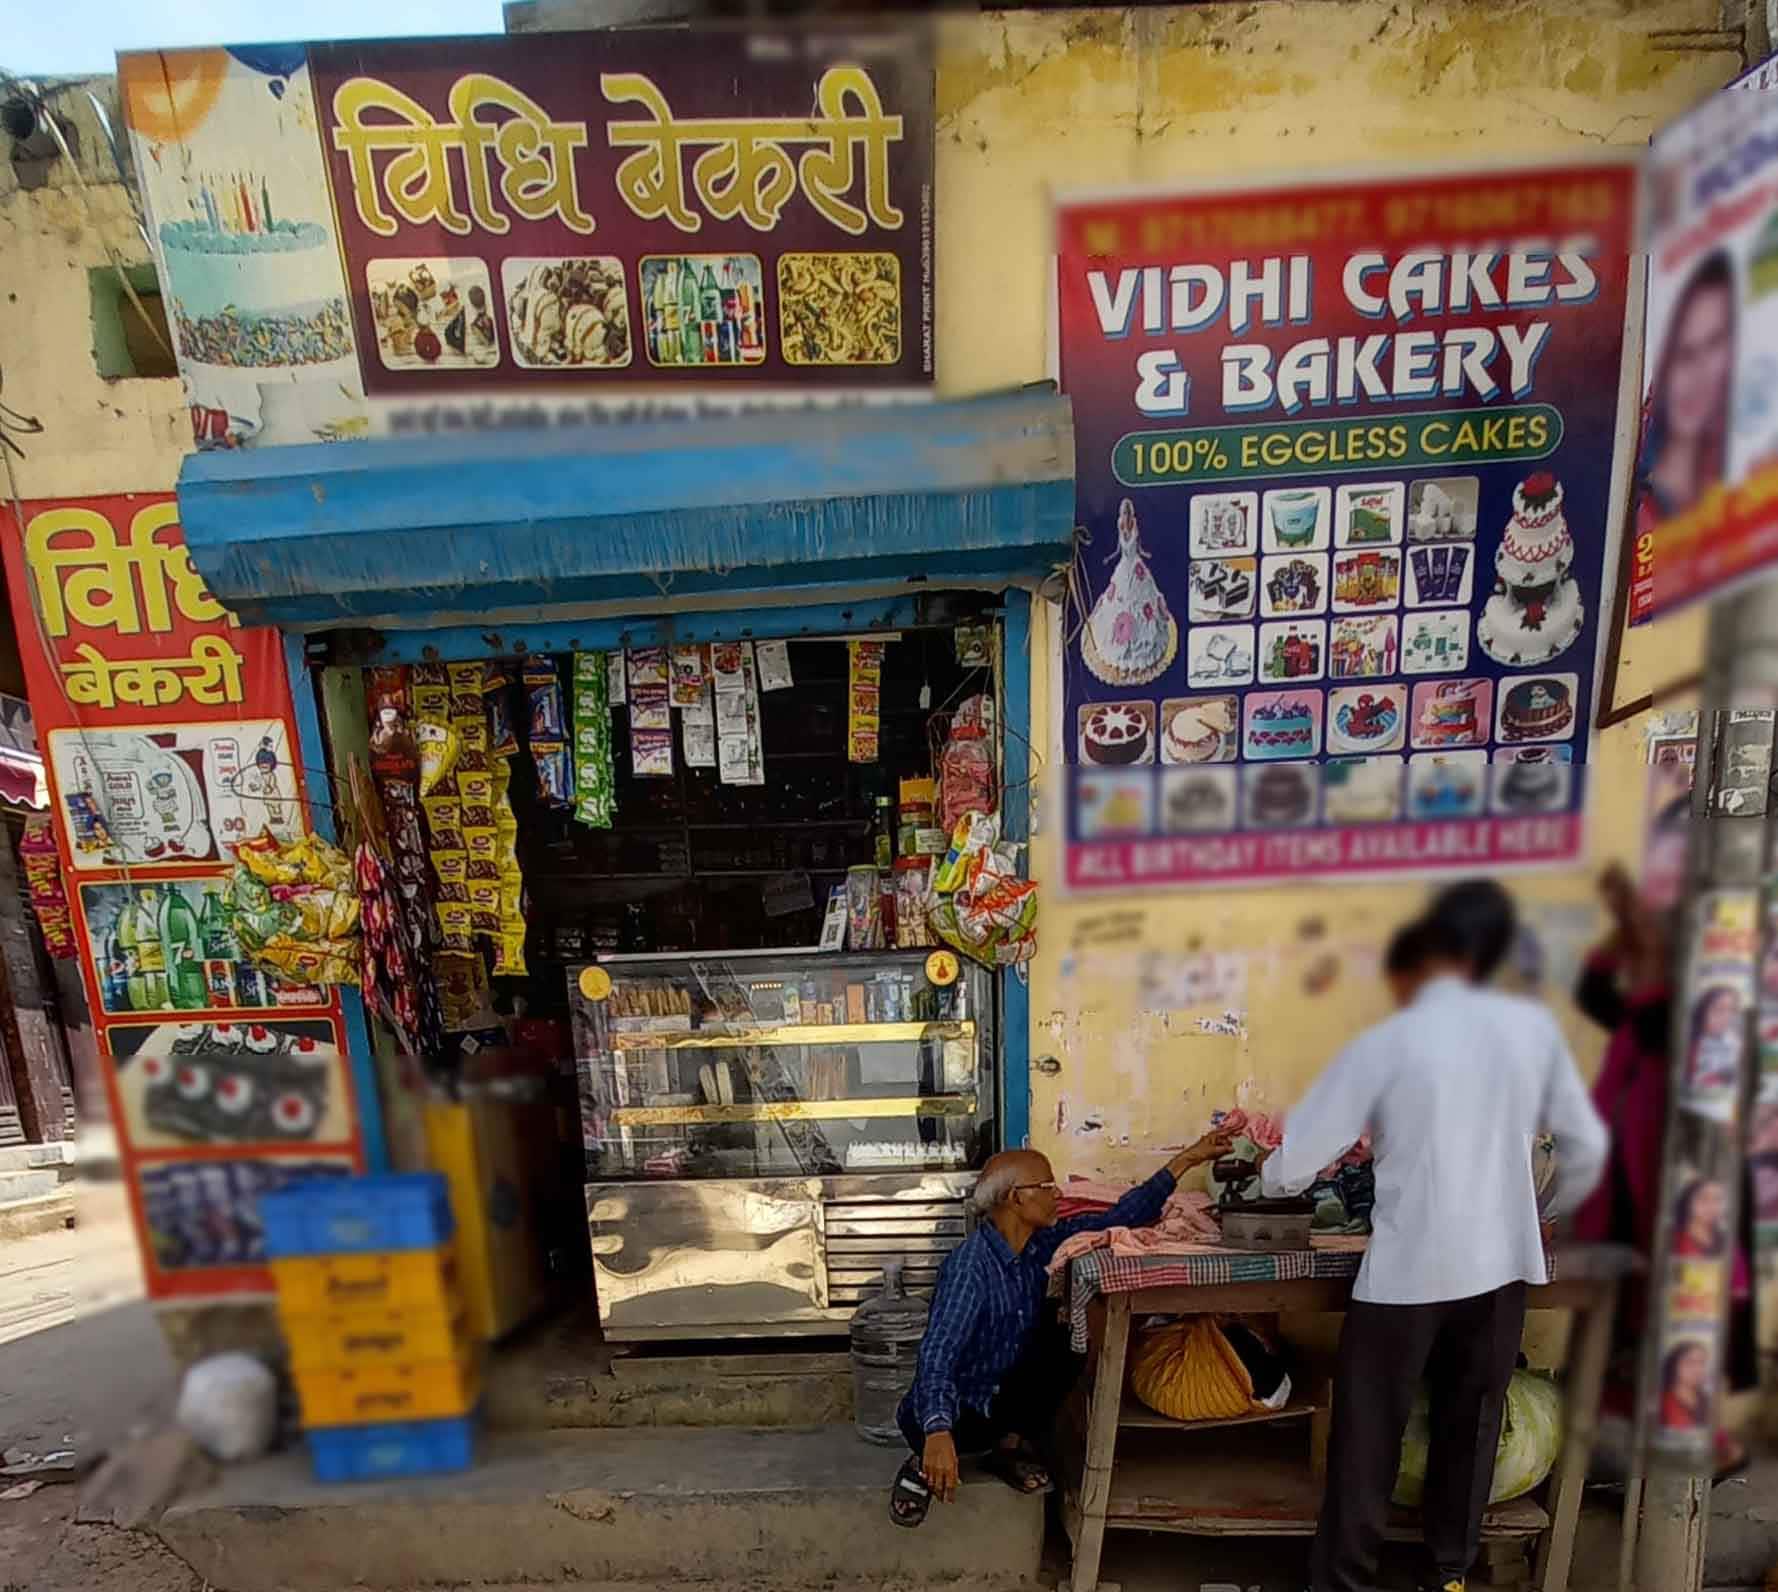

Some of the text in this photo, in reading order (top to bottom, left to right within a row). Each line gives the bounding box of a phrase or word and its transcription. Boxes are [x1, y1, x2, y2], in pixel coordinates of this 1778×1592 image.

[333, 73, 596, 236] विधि
[601, 65, 903, 235] बेकरी
[1087, 237, 1600, 338] VIDHI CAKES
[1135, 322, 1551, 415] & BAKERY
[1133, 415, 1548, 476] 100% EGGLESS CAKES
[60, 634, 244, 709] बेकरी
